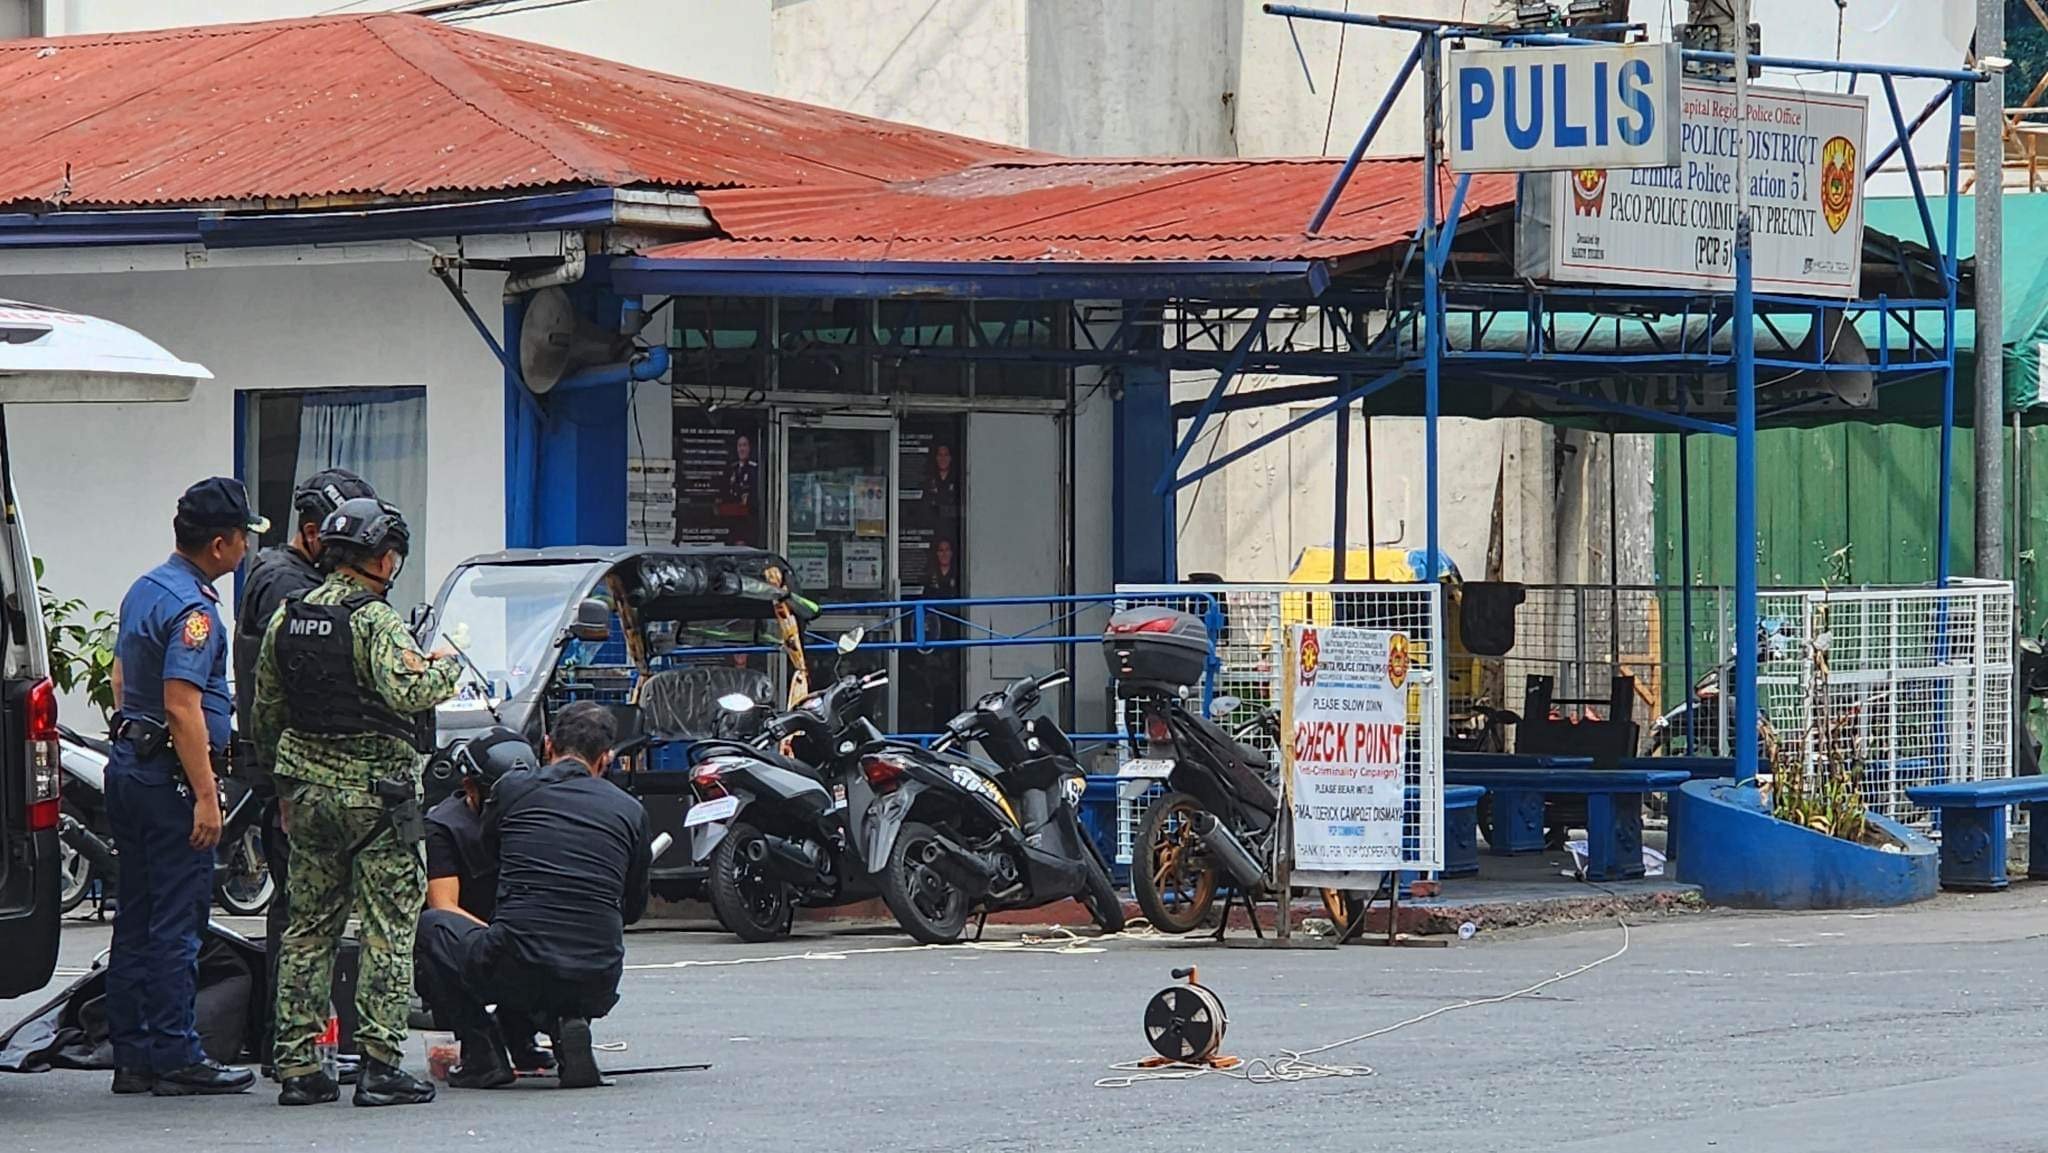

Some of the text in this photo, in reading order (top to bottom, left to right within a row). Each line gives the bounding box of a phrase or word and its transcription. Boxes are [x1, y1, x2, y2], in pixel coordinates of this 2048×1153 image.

[1459, 59, 1655, 151] PULIS
[1683, 97, 1801, 125] apital Regio Police Office
[1682, 123, 1738, 158] POLICE
[1746, 130, 1818, 165] DISTRICT
[1688, 161, 1731, 194] Police
[1736, 168, 1786, 199] ation
[1791, 172, 1800, 200] 5
[1610, 192, 1817, 237] PACO POLICE COMMUTY PRECINT
[1695, 236, 1721, 270] (PCP
[290, 619, 332, 635] MPD
[1313, 697, 1340, 711] PLEASE
[1342, 698, 1365, 712] SLOW
[1295, 721, 1403, 764] CHECK POINT
[1315, 784, 1337, 794] PLEASE
